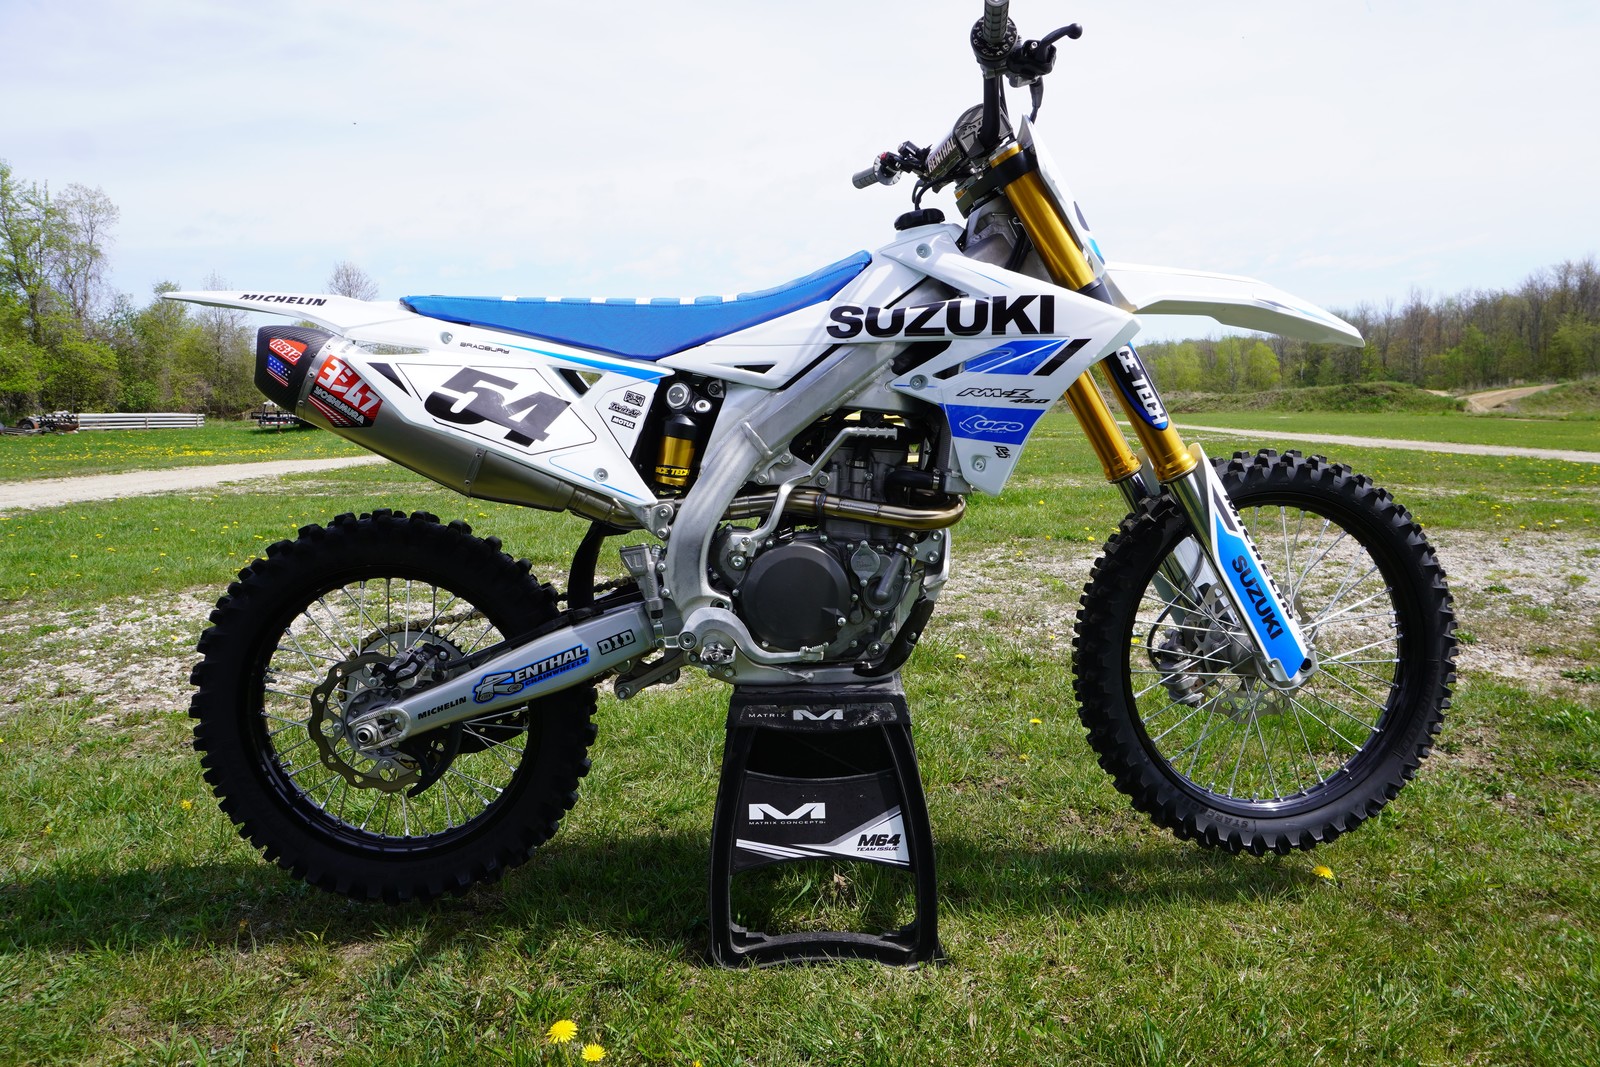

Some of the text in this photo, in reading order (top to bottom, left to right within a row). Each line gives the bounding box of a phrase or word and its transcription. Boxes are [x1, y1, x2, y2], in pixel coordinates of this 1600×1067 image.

[927, 138, 956, 172] RENTHAL
[239, 294, 328, 307] MICHELIN
[826, 294, 1055, 339] SUZUKI
[460, 342, 510, 354] BRADBURY
[313, 386, 365, 424] YOSHIMURA
[956, 387, 1035, 398] RM-Z
[1131, 374, 1168, 425] TECH
[424, 367, 572, 447] 54
[612, 416, 635, 429] MOTUL
[671, 468, 690, 476] TECH
[1232, 554, 1284, 641] SUZUKI
[475, 647, 586, 701] RENTHAL
[525, 659, 587, 685] CHAINWHEELS
[418, 696, 467, 720] MICHELIN
[857, 833, 902, 847] M64
